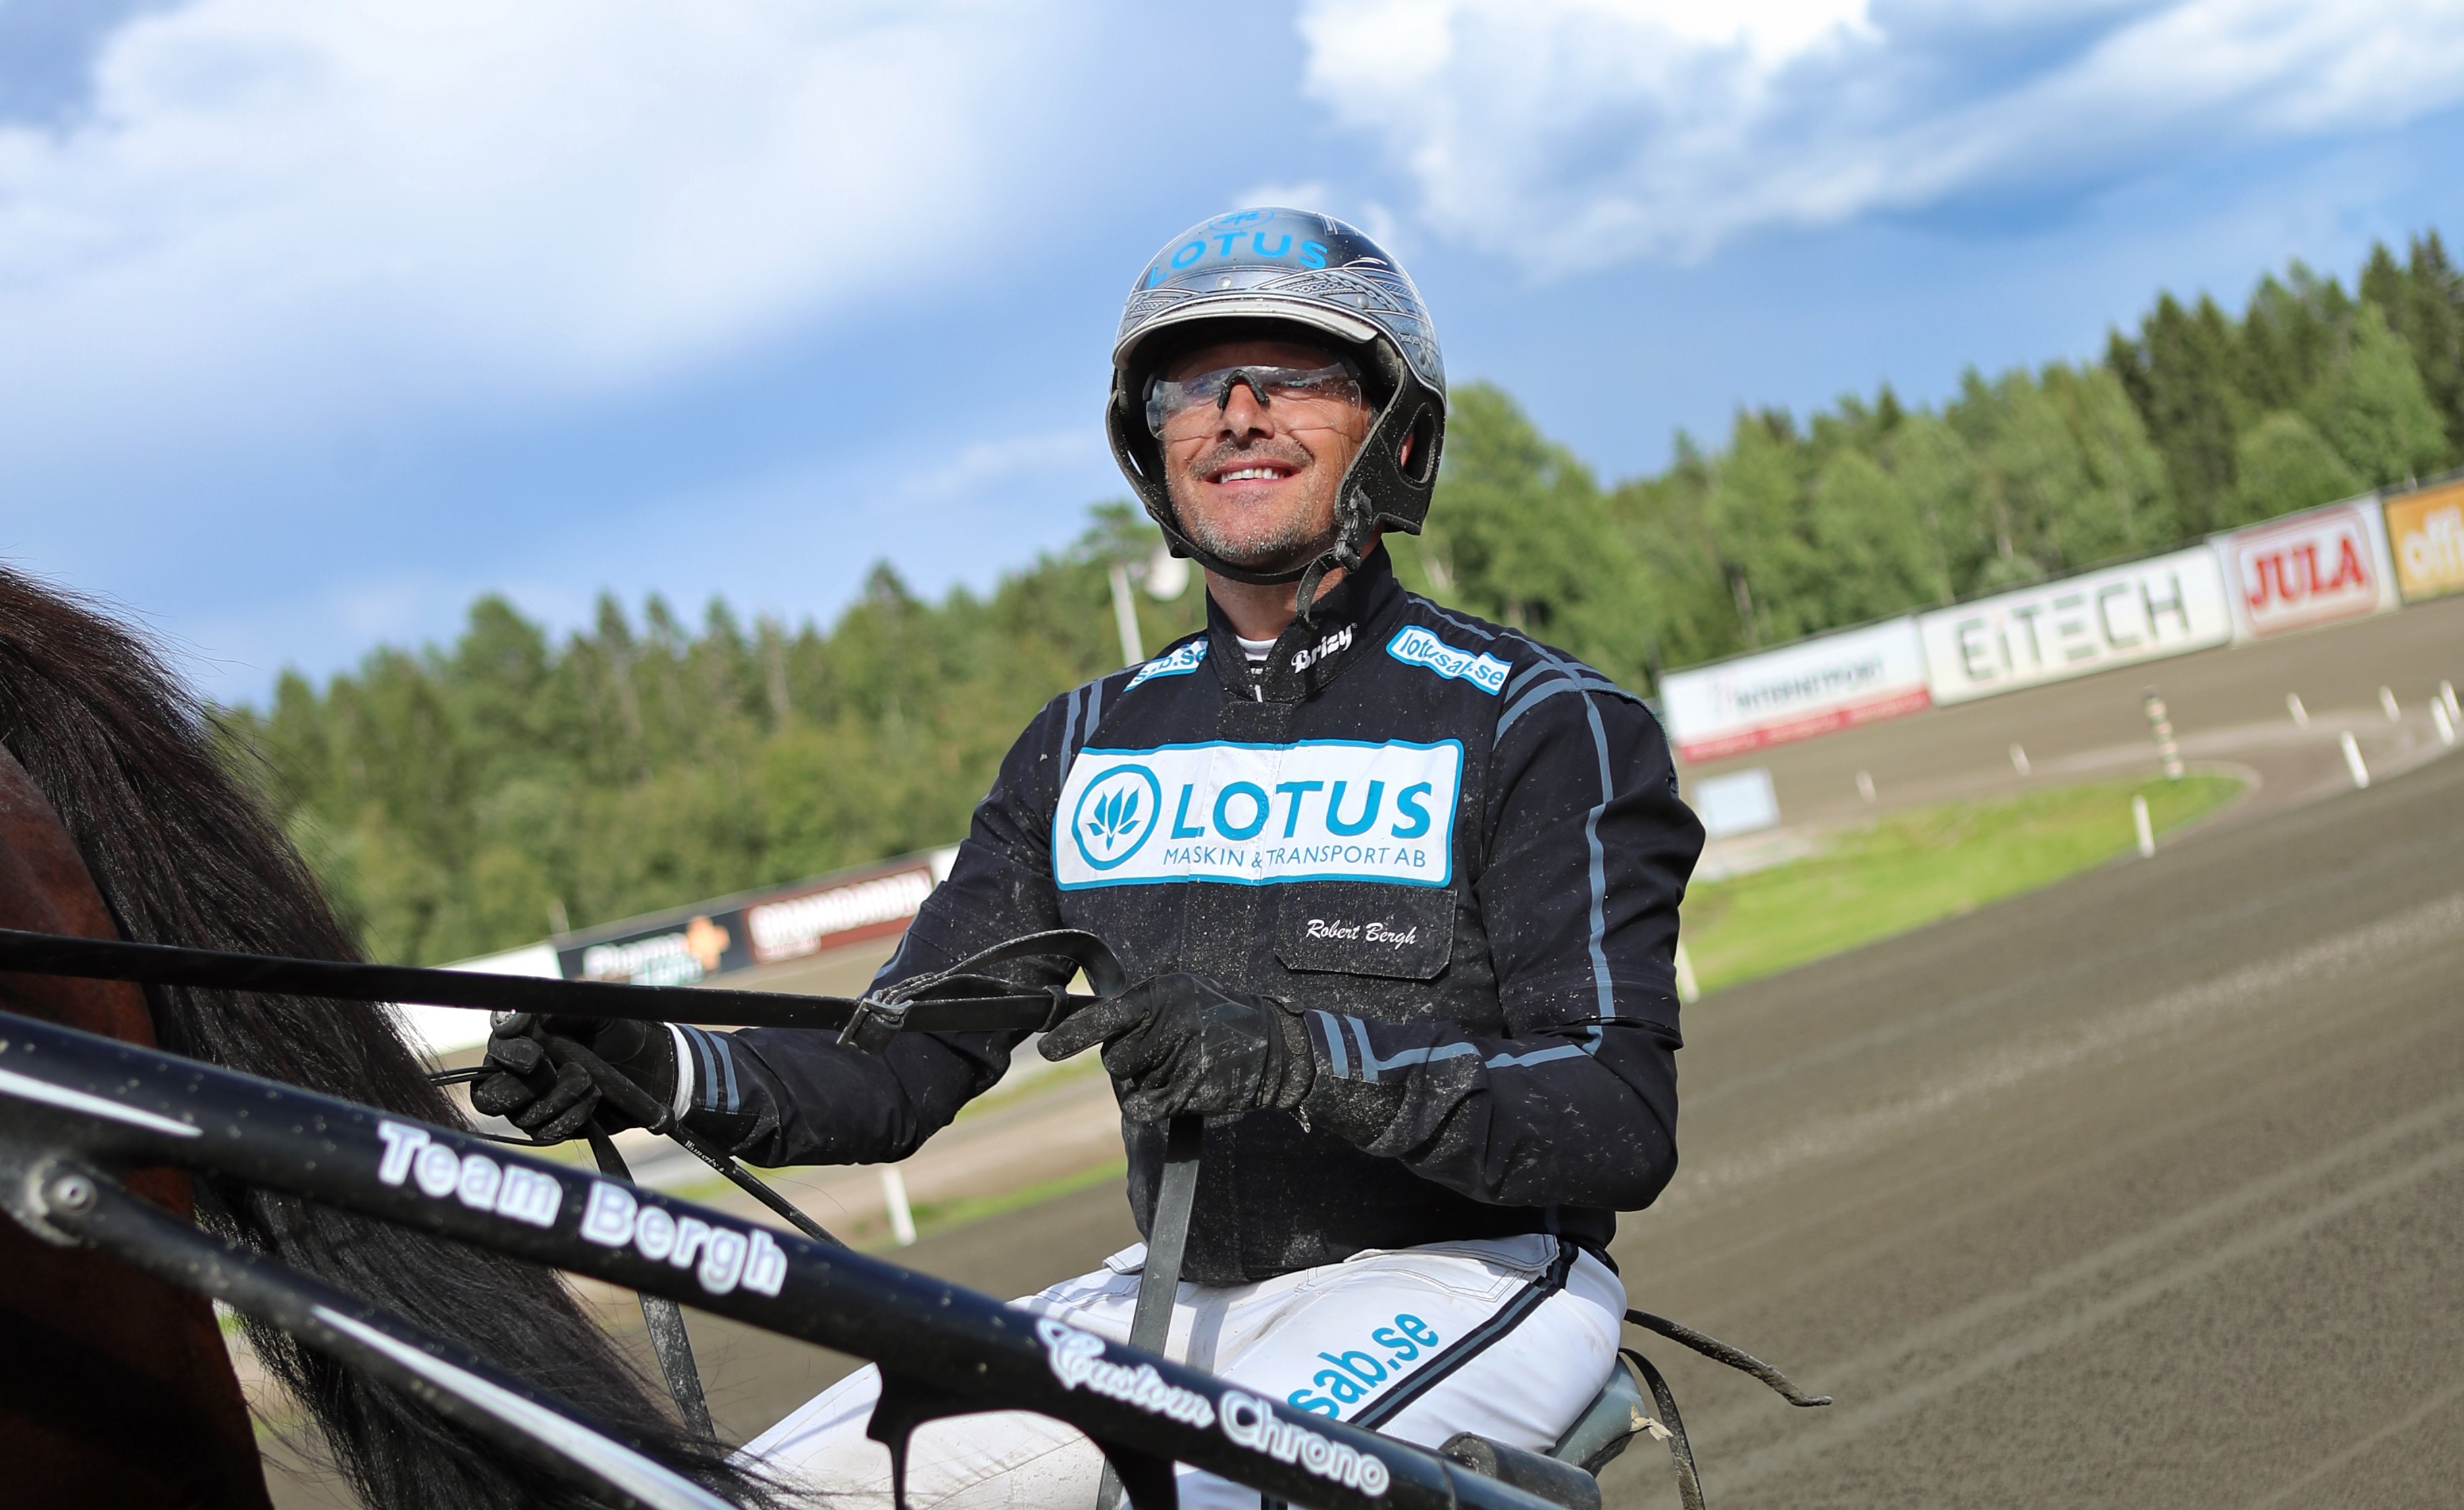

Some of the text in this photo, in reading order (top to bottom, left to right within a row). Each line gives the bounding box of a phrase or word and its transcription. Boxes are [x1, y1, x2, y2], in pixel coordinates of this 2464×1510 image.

[1149, 231, 1327, 288] LOTUS
[2247, 538, 2366, 609] JULA
[1171, 779, 1432, 841] LOTUS
[1163, 845, 1426, 868] MASKIN & TRANSPORT AB
[1306, 919, 1418, 951] Robert Bergh
[378, 1120, 788, 1297] Team Bergh
[1287, 1313, 1439, 1420] sab.se
[1037, 1317, 1390, 1498] Custom Chrono
